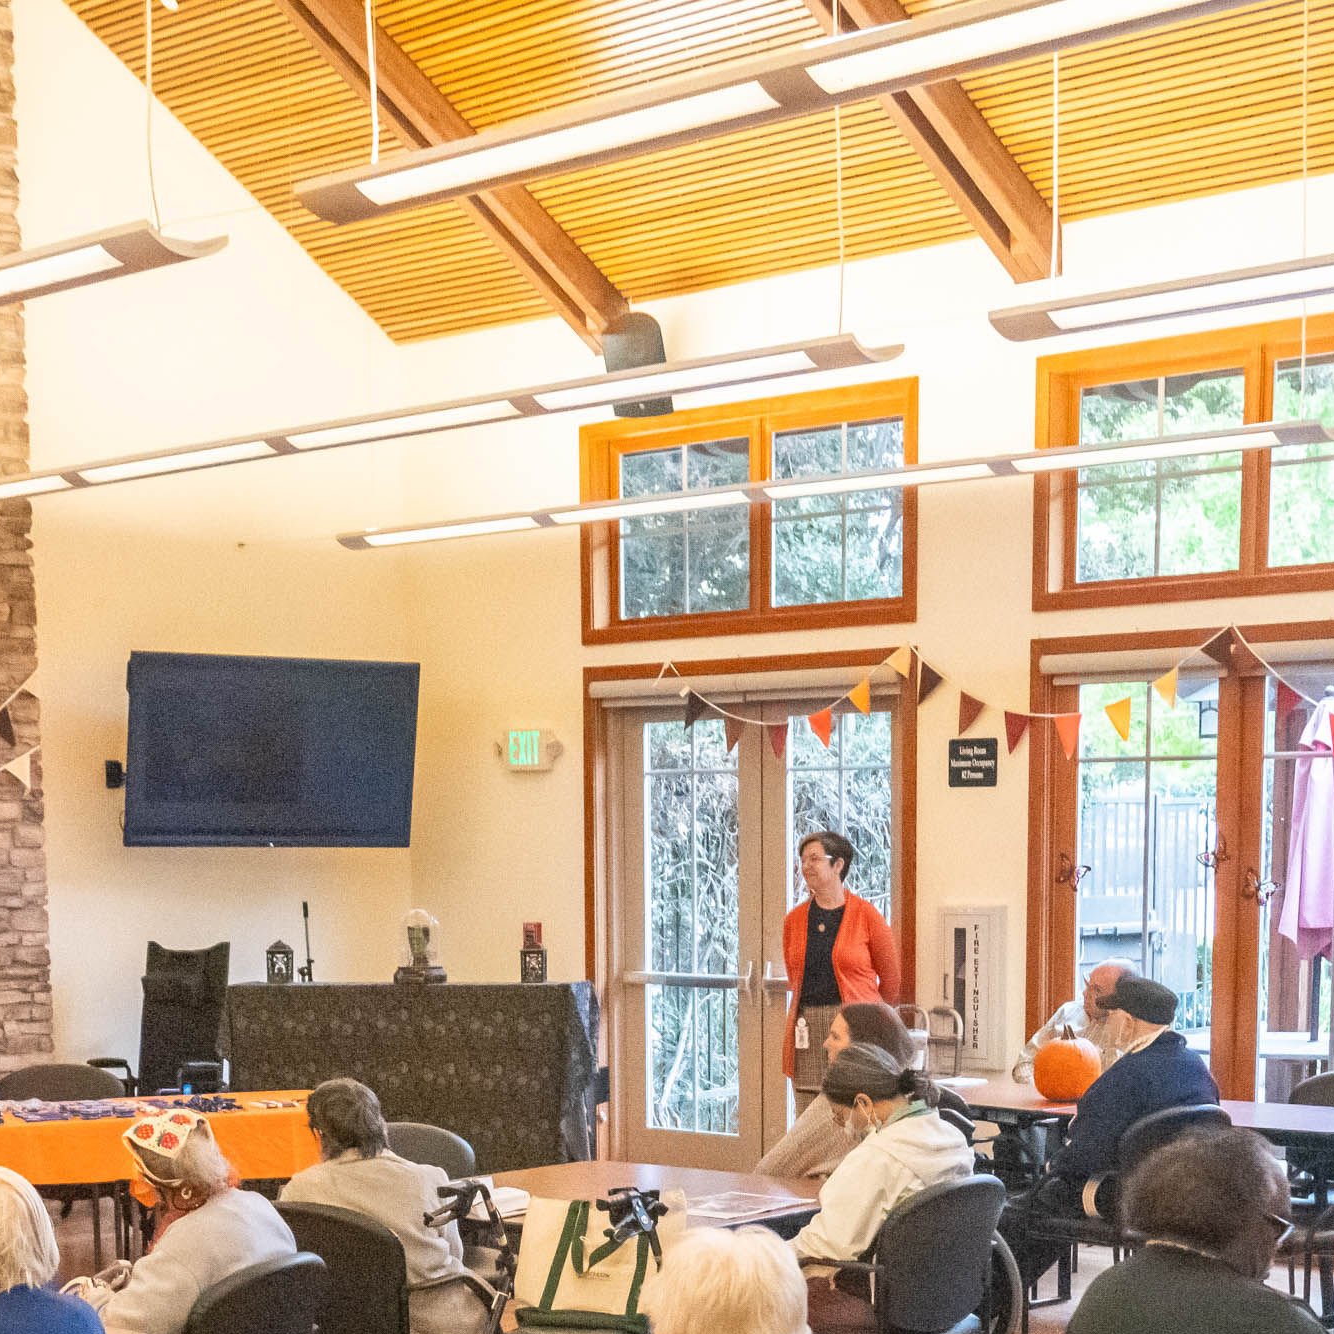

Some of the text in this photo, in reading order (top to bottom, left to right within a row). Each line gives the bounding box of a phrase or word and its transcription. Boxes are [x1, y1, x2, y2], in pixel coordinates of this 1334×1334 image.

[509, 730, 539, 765] EXIT
[973, 746, 987, 755] Room
[971, 758, 995, 768] Occupancy
[972, 958, 980, 1050] EXTINGUISHER
